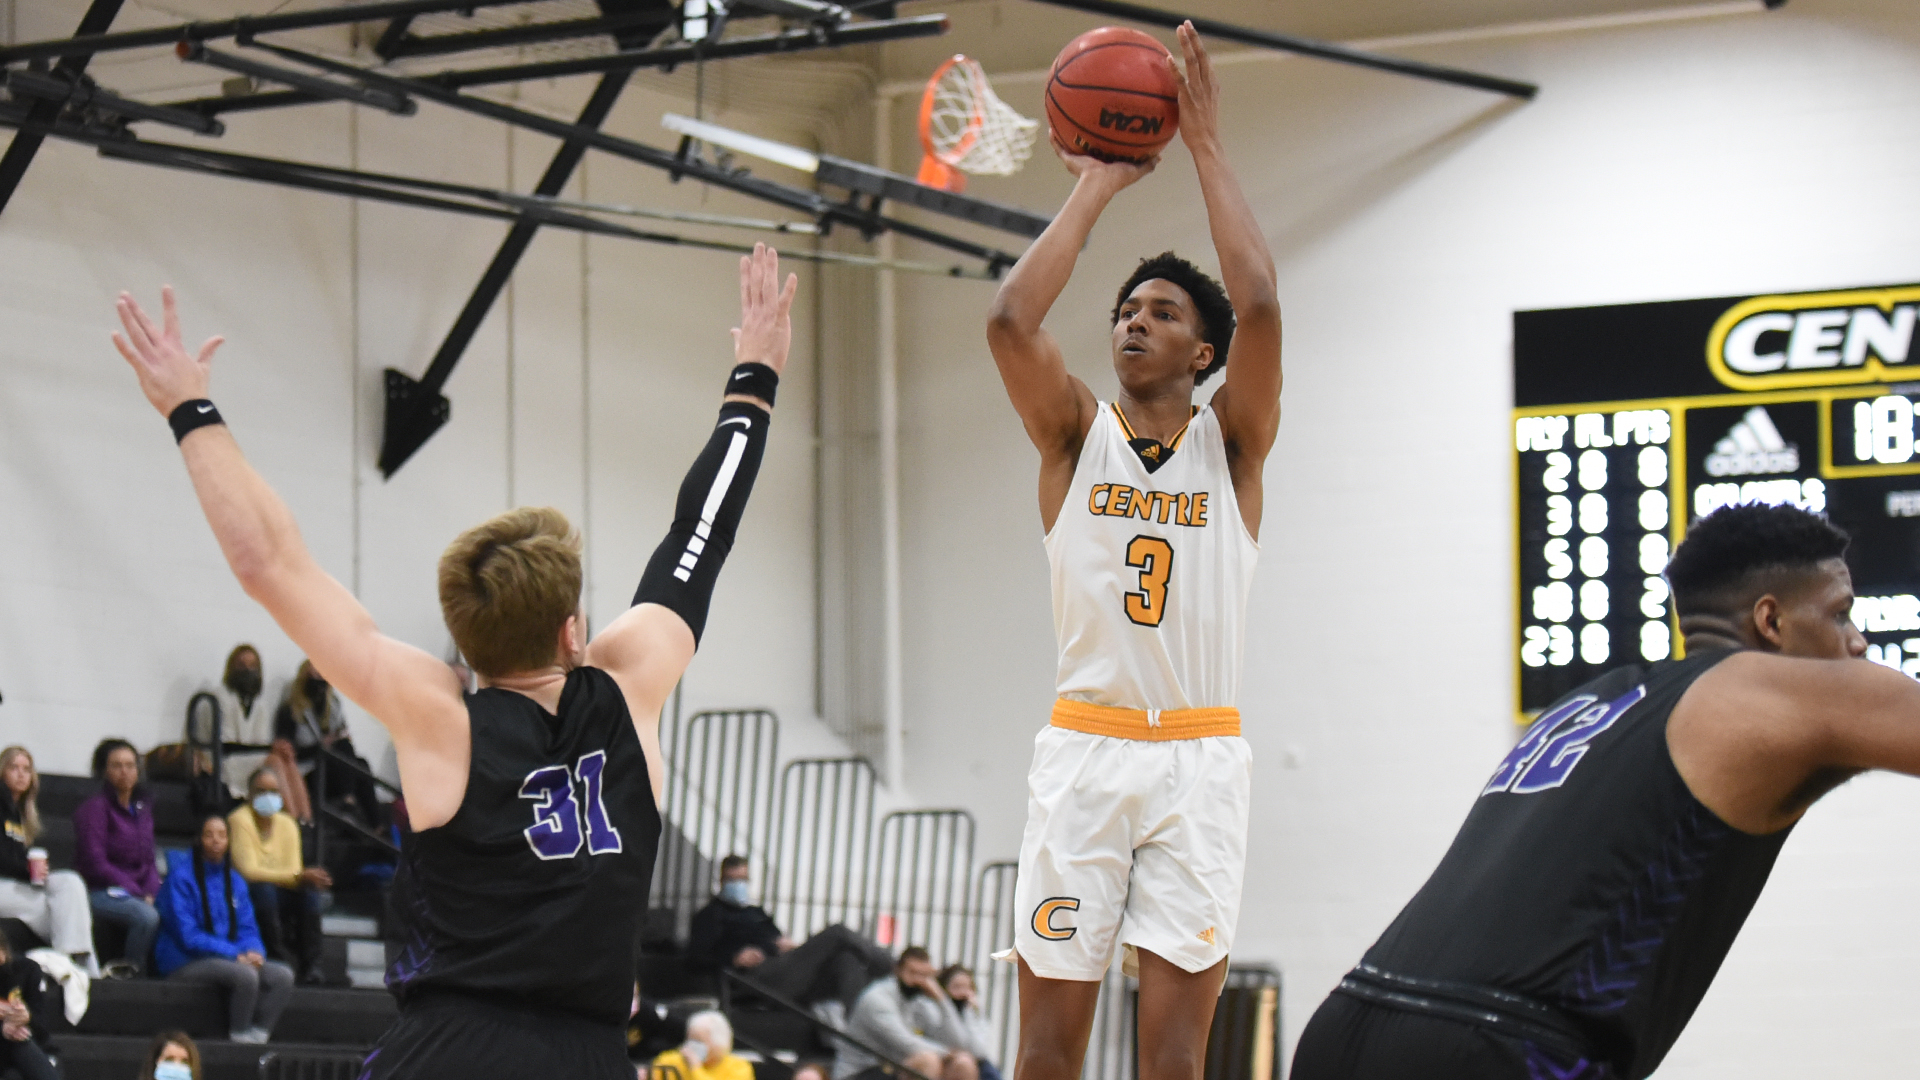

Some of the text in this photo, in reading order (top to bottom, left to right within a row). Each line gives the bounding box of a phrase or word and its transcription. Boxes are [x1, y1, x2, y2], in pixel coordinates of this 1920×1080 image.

[1099, 107, 1165, 135] NCAA
[1723, 305, 1920, 373] CEN
[1613, 409, 1671, 446] PTS
[1543, 451, 1572, 493] 2
[1088, 482, 1209, 527] CENTRE
[1546, 494, 1573, 536] 3
[1544, 537, 1574, 580] 5
[1124, 534, 1174, 628] 3
[1640, 576, 1669, 619] 2
[1521, 624, 1574, 667] 23
[518, 749, 622, 860] 31
[1031, 896, 1081, 942] C
